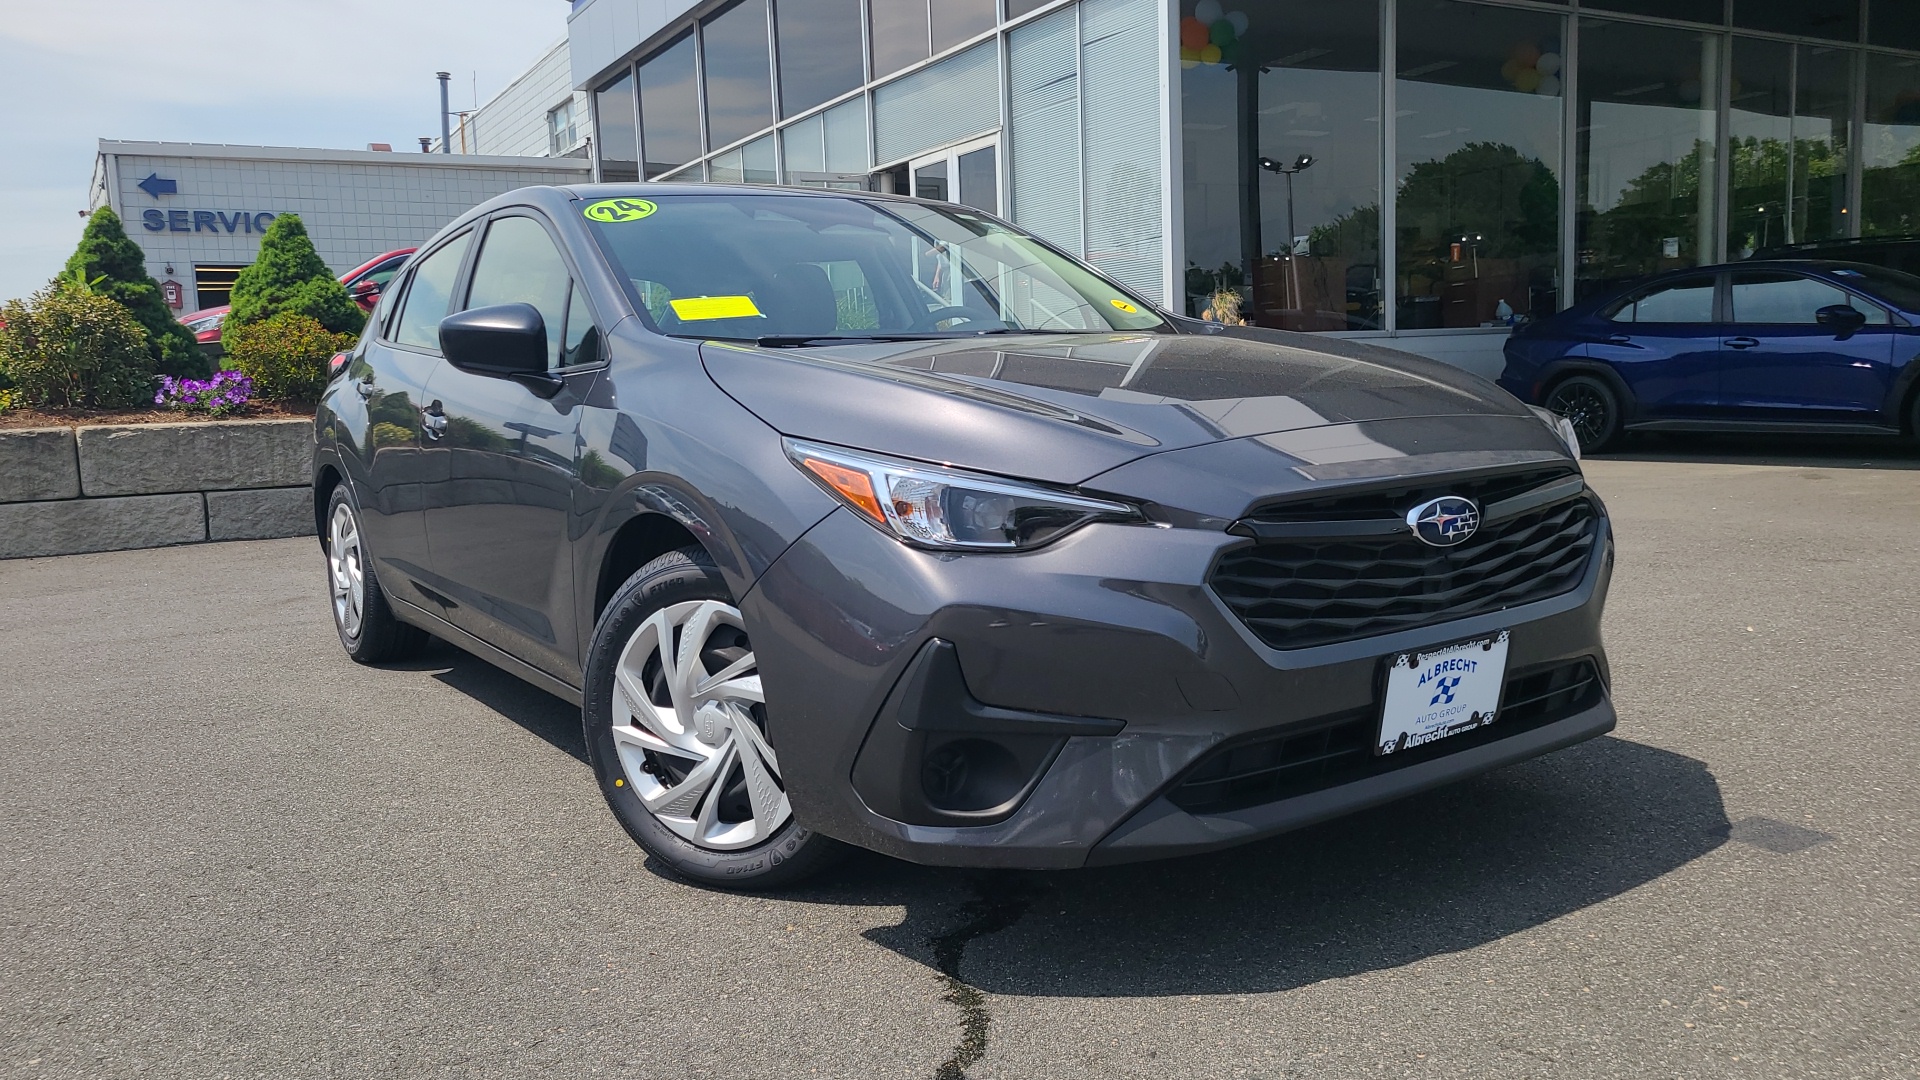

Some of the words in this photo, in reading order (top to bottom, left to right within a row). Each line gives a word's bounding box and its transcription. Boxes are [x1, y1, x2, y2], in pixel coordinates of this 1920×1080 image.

[143, 208, 298, 234] SERVIC
[597, 200, 647, 220] 24
[1417, 659, 1477, 688] ALBRECHT
[1415, 712, 1437, 725] AUTO
[1439, 703, 1467, 719] GROUP
[1403, 726, 1448, 749] Albrecht
[1448, 727, 1461, 736] AUTO
[1461, 723, 1477, 732] GROUP
